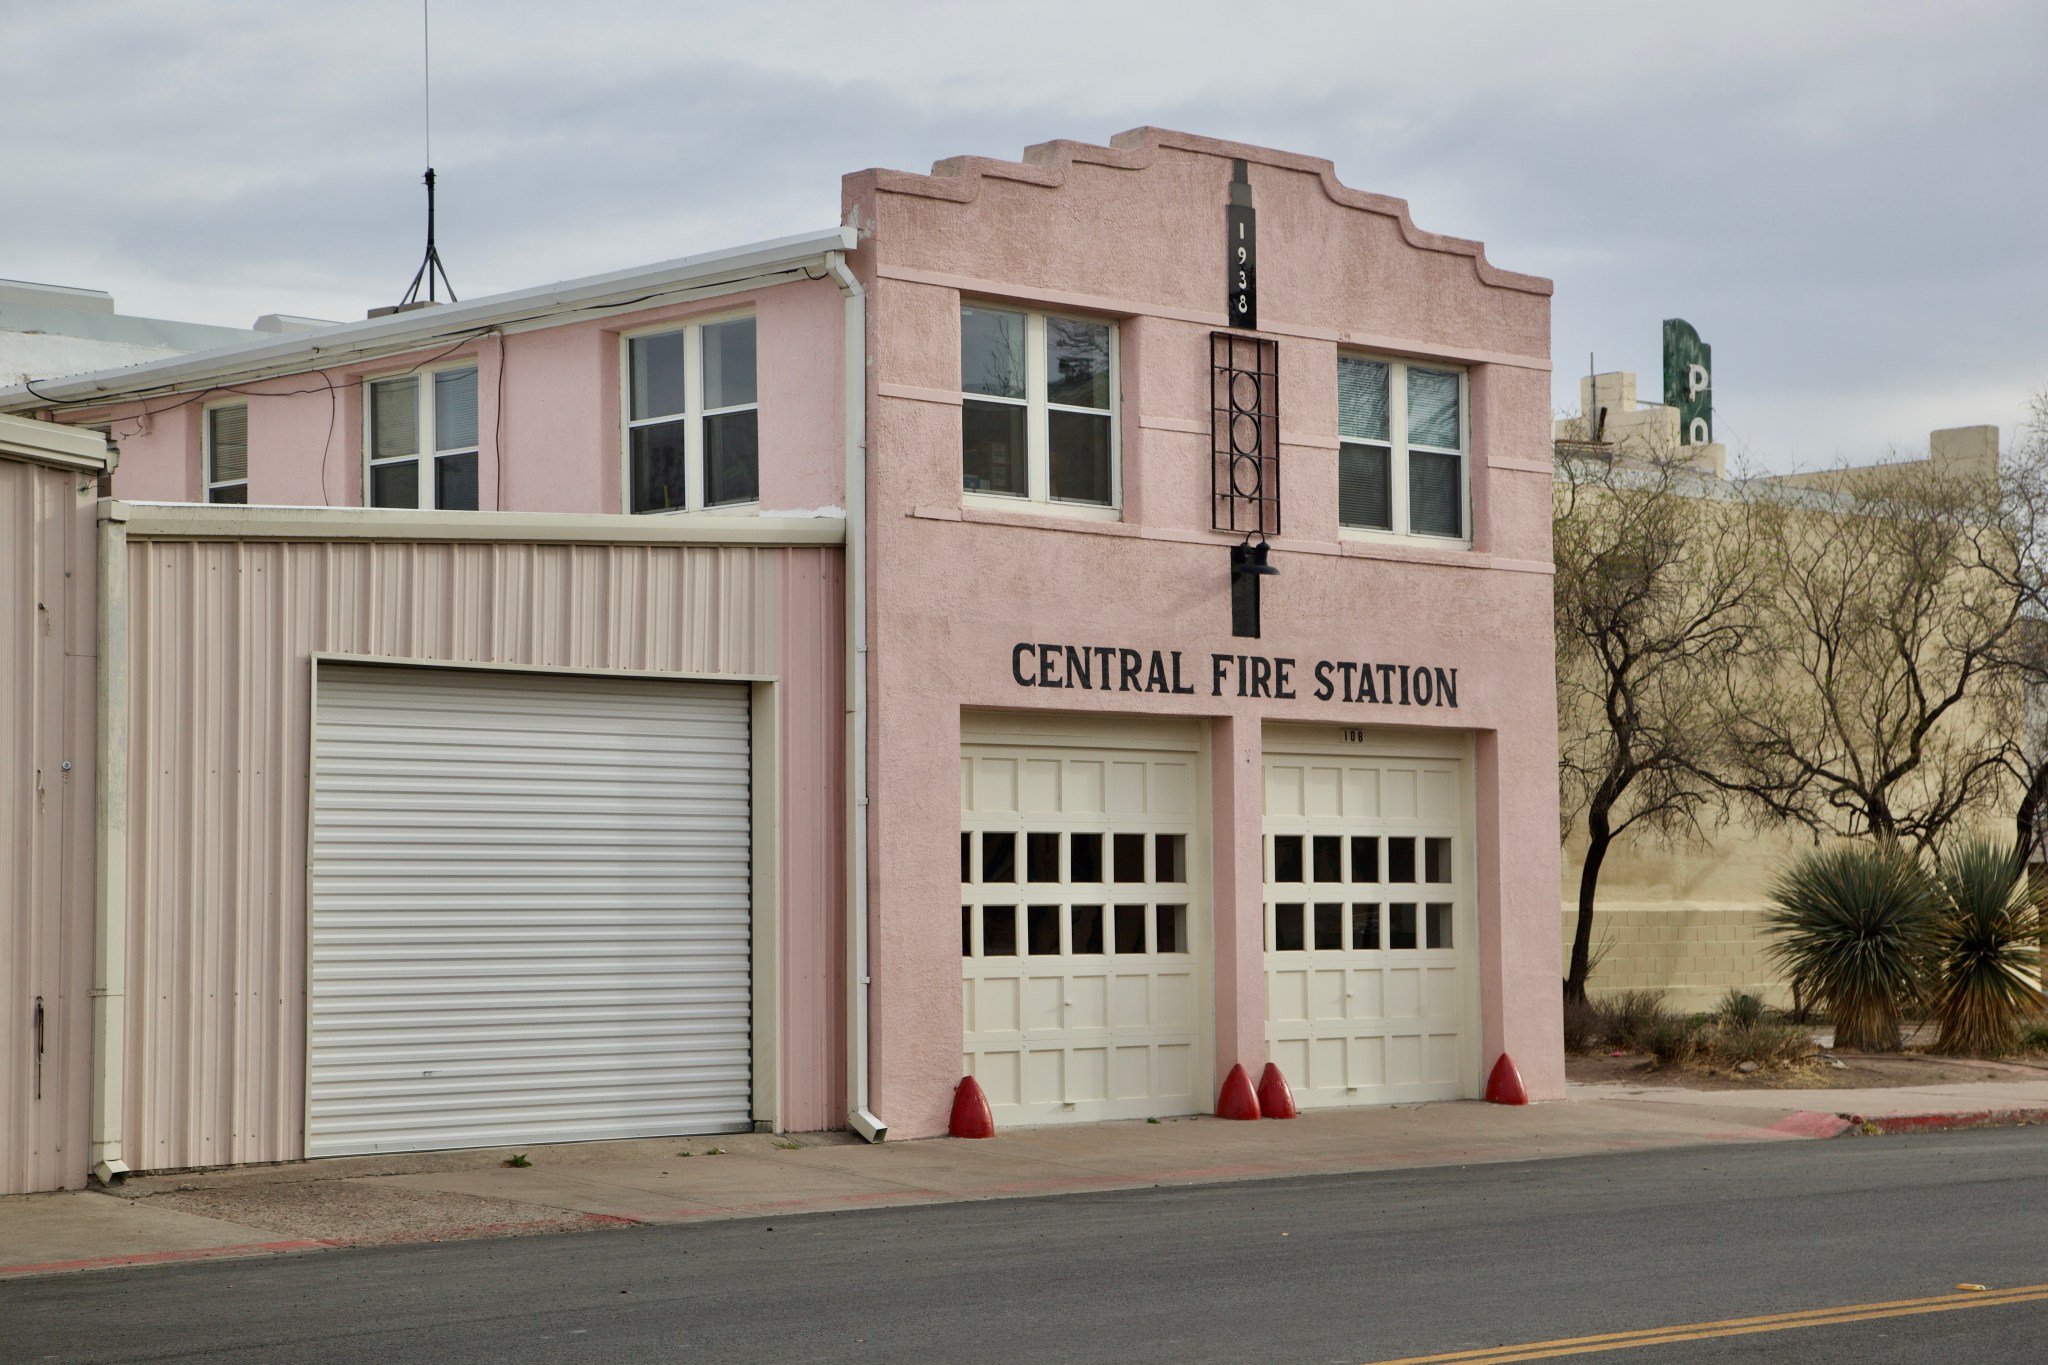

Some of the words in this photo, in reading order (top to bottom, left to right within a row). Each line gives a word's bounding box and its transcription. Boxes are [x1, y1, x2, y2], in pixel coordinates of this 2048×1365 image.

[1237, 222, 1248, 313] 1938
[1012, 643, 1195, 694] CENTRAL
[1211, 654, 1297, 699] FIRE
[1313, 660, 1458, 708] STATION
[1344, 730, 1363, 742] 108
